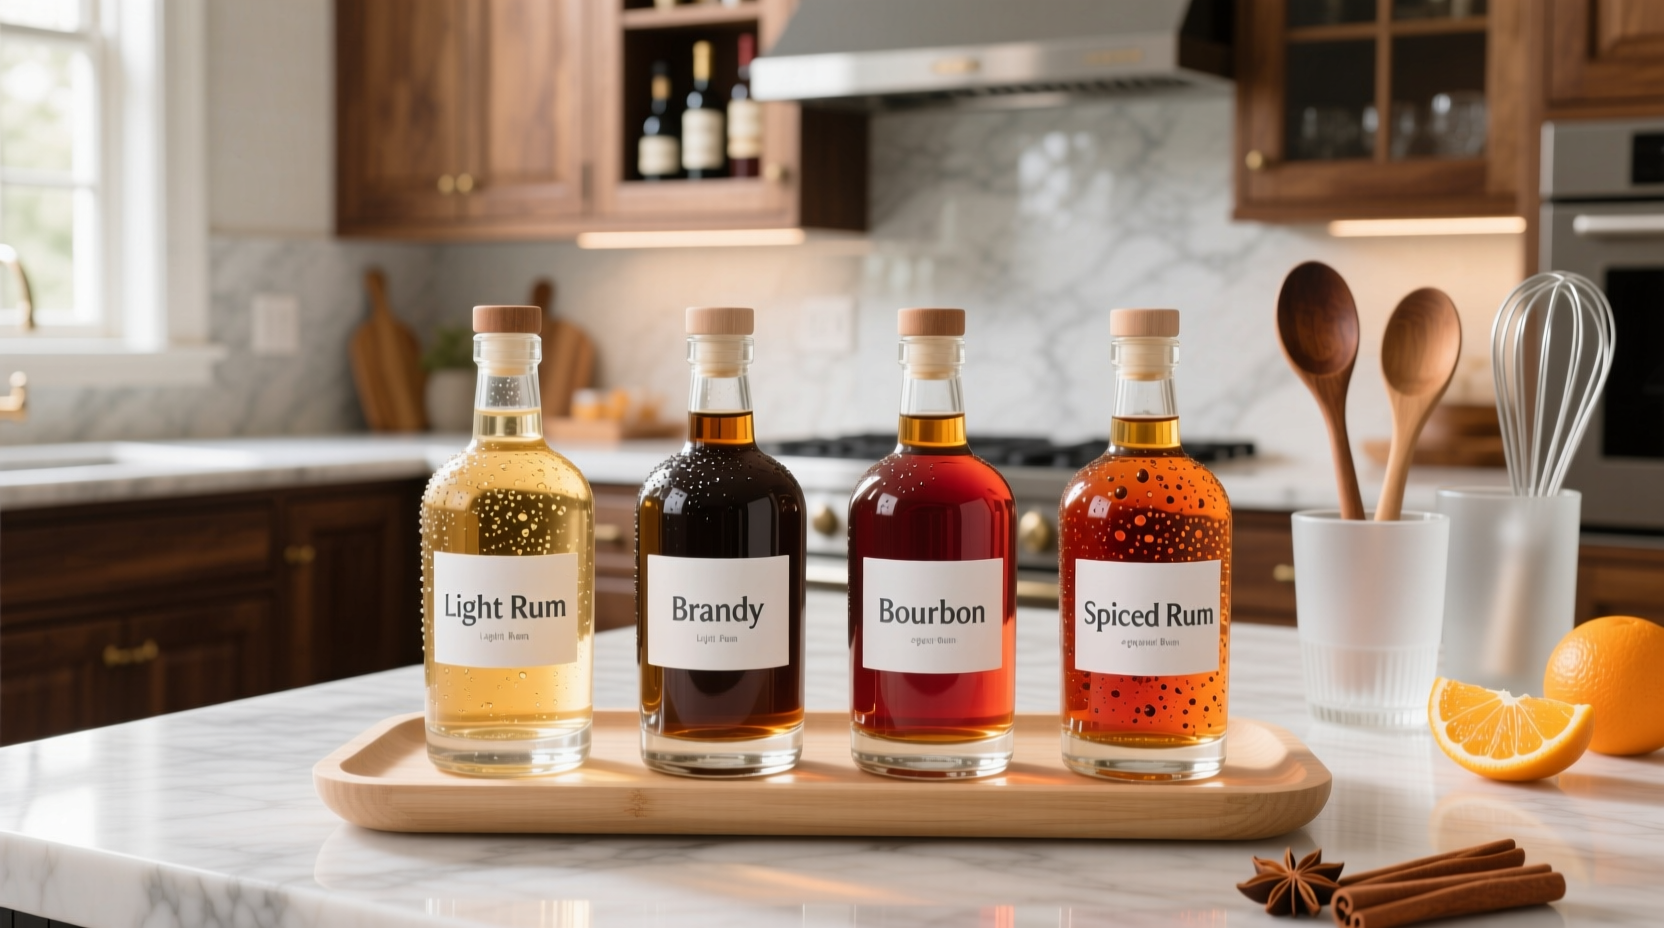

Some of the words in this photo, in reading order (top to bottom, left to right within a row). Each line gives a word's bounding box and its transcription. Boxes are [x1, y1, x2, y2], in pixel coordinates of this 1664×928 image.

[445, 593, 503, 626] Light
[511, 595, 566, 619] Rum
[672, 596, 764, 629] Brandy
[879, 598, 985, 624] Bourbon
[1084, 601, 1159, 632] Spiced
[1167, 603, 1213, 627] Rum
